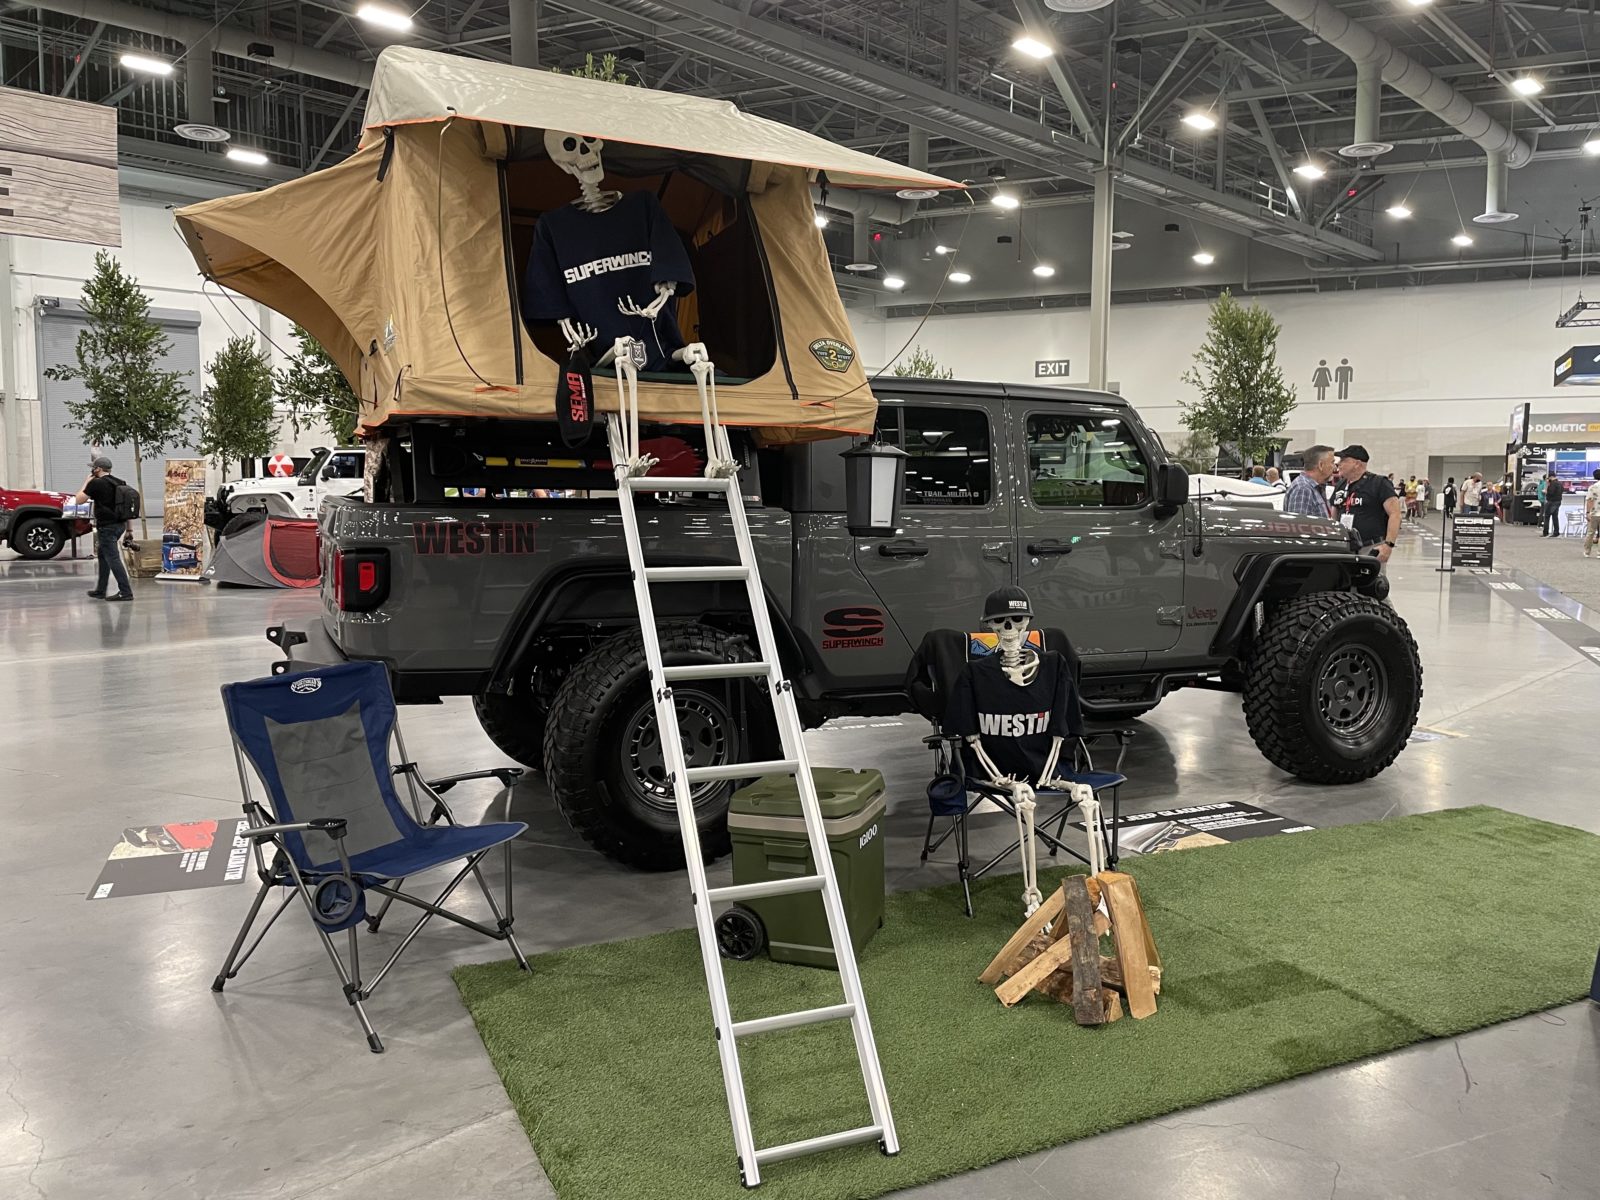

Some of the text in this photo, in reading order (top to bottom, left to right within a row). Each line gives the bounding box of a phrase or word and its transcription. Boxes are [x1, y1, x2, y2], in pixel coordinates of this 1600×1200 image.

[829, 349, 838, 361] 2
[1038, 362, 1068, 375] EXIT
[566, 372, 585, 422] SEMA
[1535, 423, 1586, 432] DOMETIC
[822, 637, 885, 650] SUPERWINCH
[859, 823, 878, 850] IGLOO
